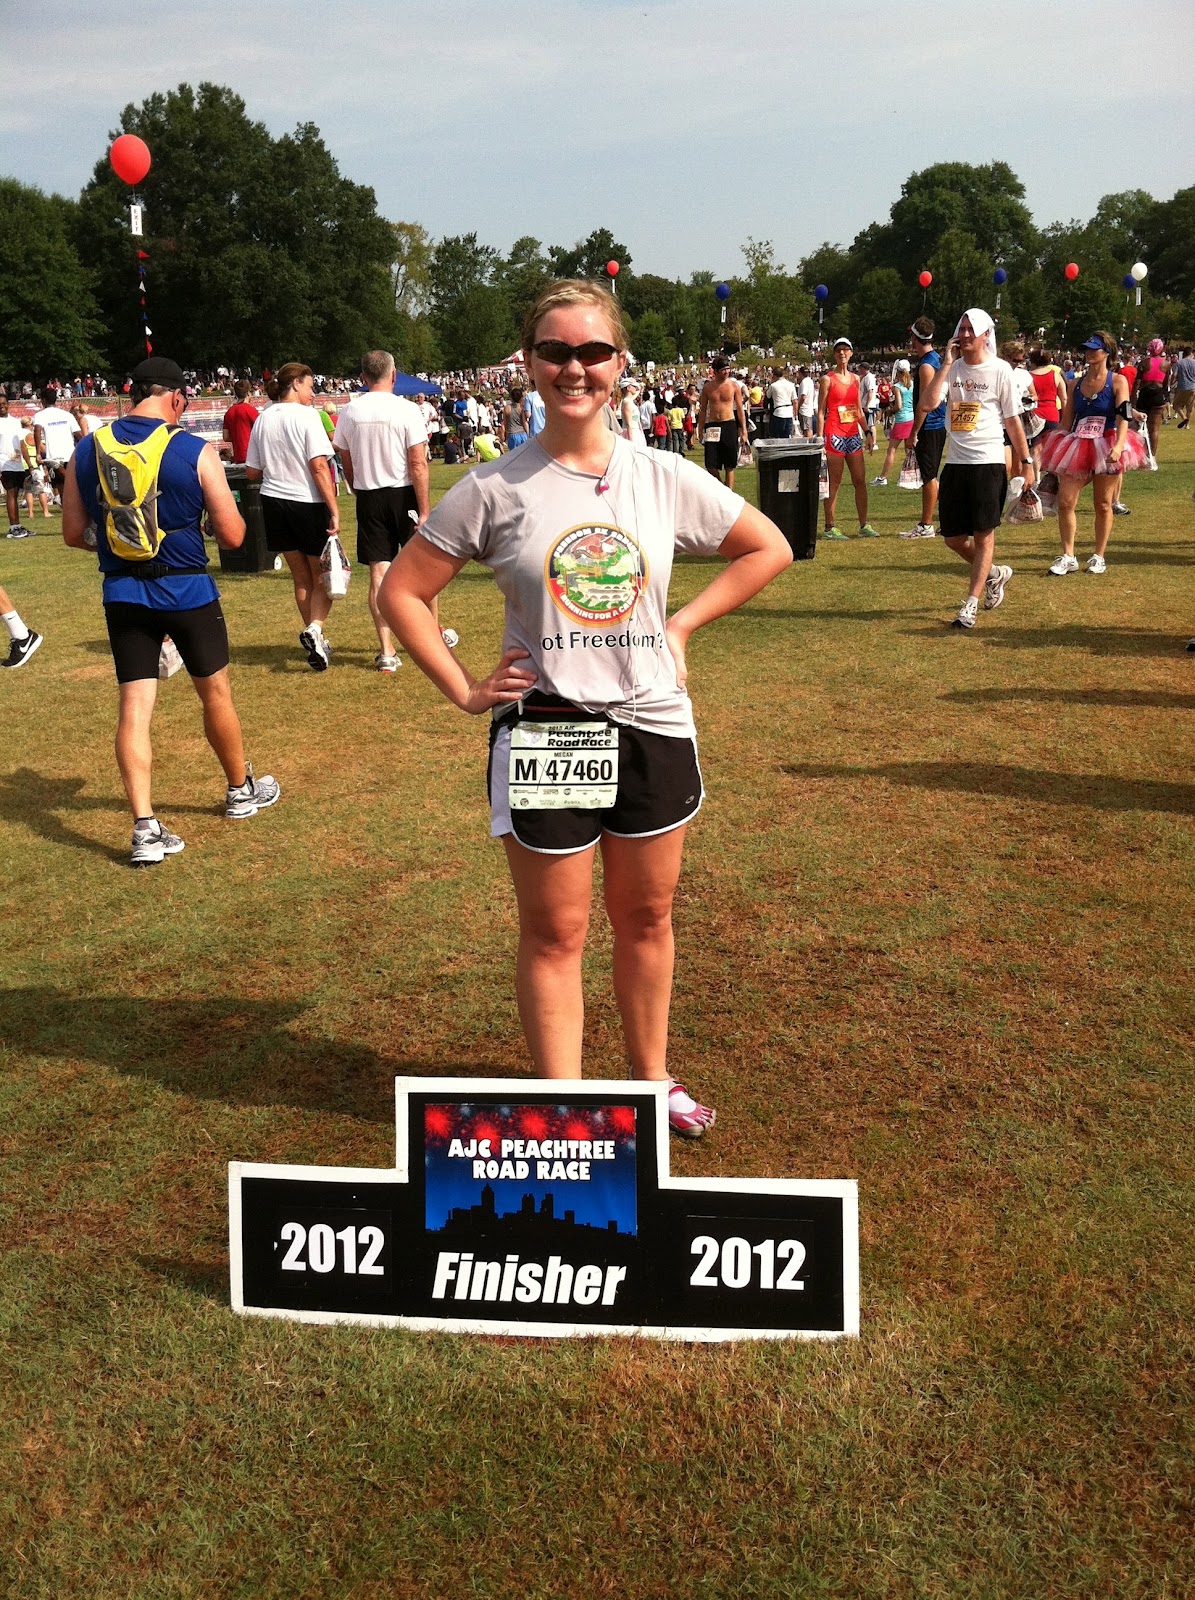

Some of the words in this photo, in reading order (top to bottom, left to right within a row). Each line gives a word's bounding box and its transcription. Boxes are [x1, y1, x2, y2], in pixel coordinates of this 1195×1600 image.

[560, 594, 594, 620] RUNNING
[594, 612, 612, 620] FOR
[612, 608, 620, 617] A
[548, 729, 612, 739] Peachtree
[448, 1138, 492, 1159] AJC
[501, 1139, 616, 1160] PEACHTREE
[473, 1160, 530, 1180] ROAD
[536, 1161, 591, 1181] RACE
[280, 1222, 385, 1276] 2012
[689, 1236, 806, 1291] 2012
[432, 1252, 627, 1306] Finisher
